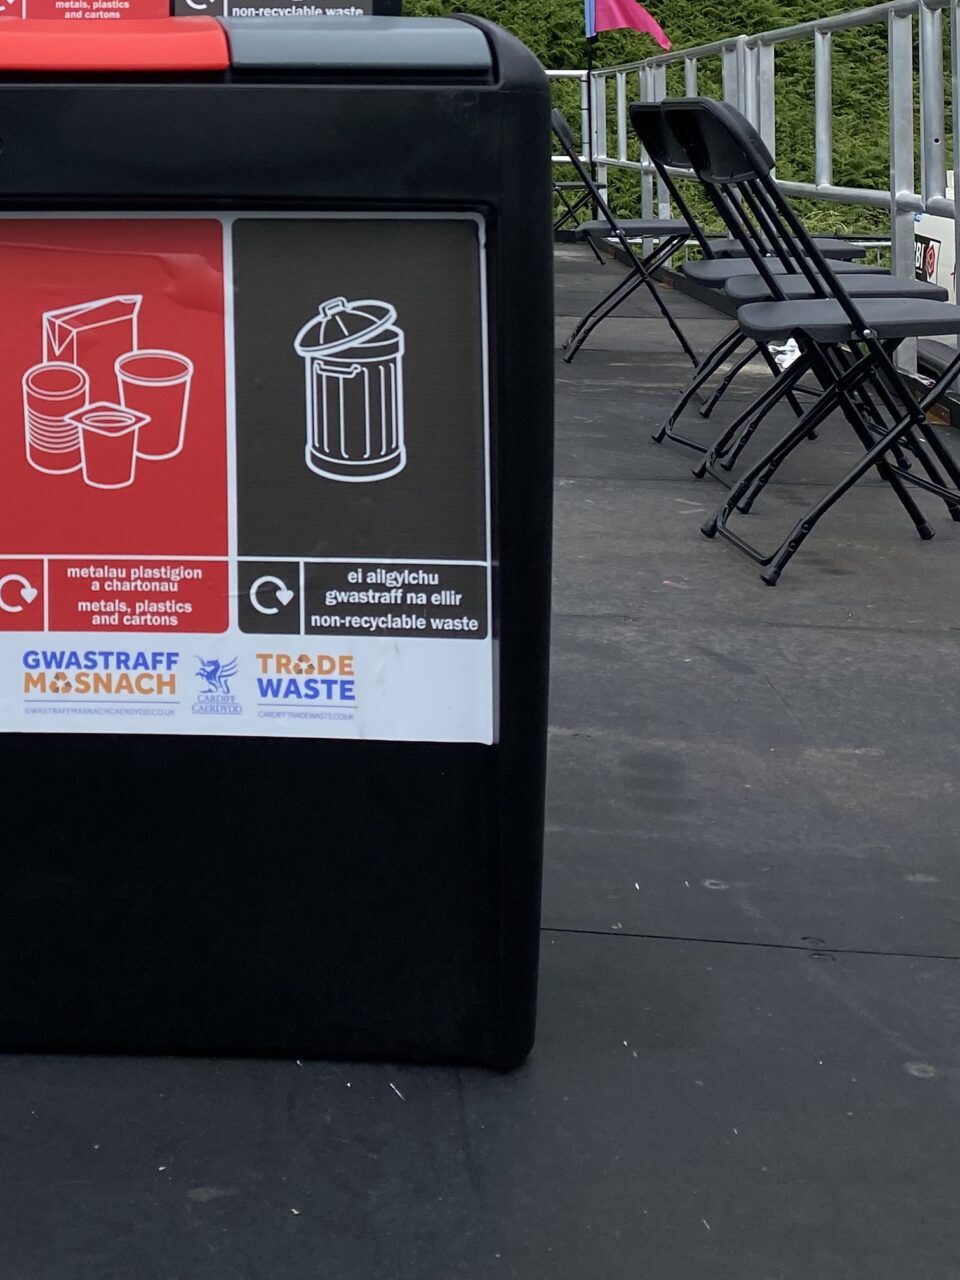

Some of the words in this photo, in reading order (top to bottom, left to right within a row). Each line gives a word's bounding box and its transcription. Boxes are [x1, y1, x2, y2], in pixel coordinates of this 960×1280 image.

[55, 0, 90, 8] metals,
[92, 0, 130, 9] plastics
[232, 6, 323, 16] non-recyclable
[325, 6, 364, 16] waste
[64, 10, 82, 18] and
[84, 11, 120, 19] cartons
[67, 565, 126, 578] metalau
[130, 565, 202, 581] plastigion
[347, 568, 362, 583] ei
[366, 569, 439, 587] ailgylchu
[91, 581, 100, 591] a
[104, 579, 179, 592] chartonau
[325, 588, 403, 606] gwastraff
[406, 592, 427, 604] na
[431, 590, 462, 605] ellir
[78, 599, 131, 613] metals,
[136, 599, 193, 614] plastics
[92, 613, 118, 625] and
[123, 614, 179, 626] cartons
[311, 614, 427, 631] non-recyclable
[430, 616, 478, 631] waste
[23, 650, 180, 671] GWASTRAFF
[257, 677, 356, 701] WASTE
[197, 695, 236, 703] CARDIFF
